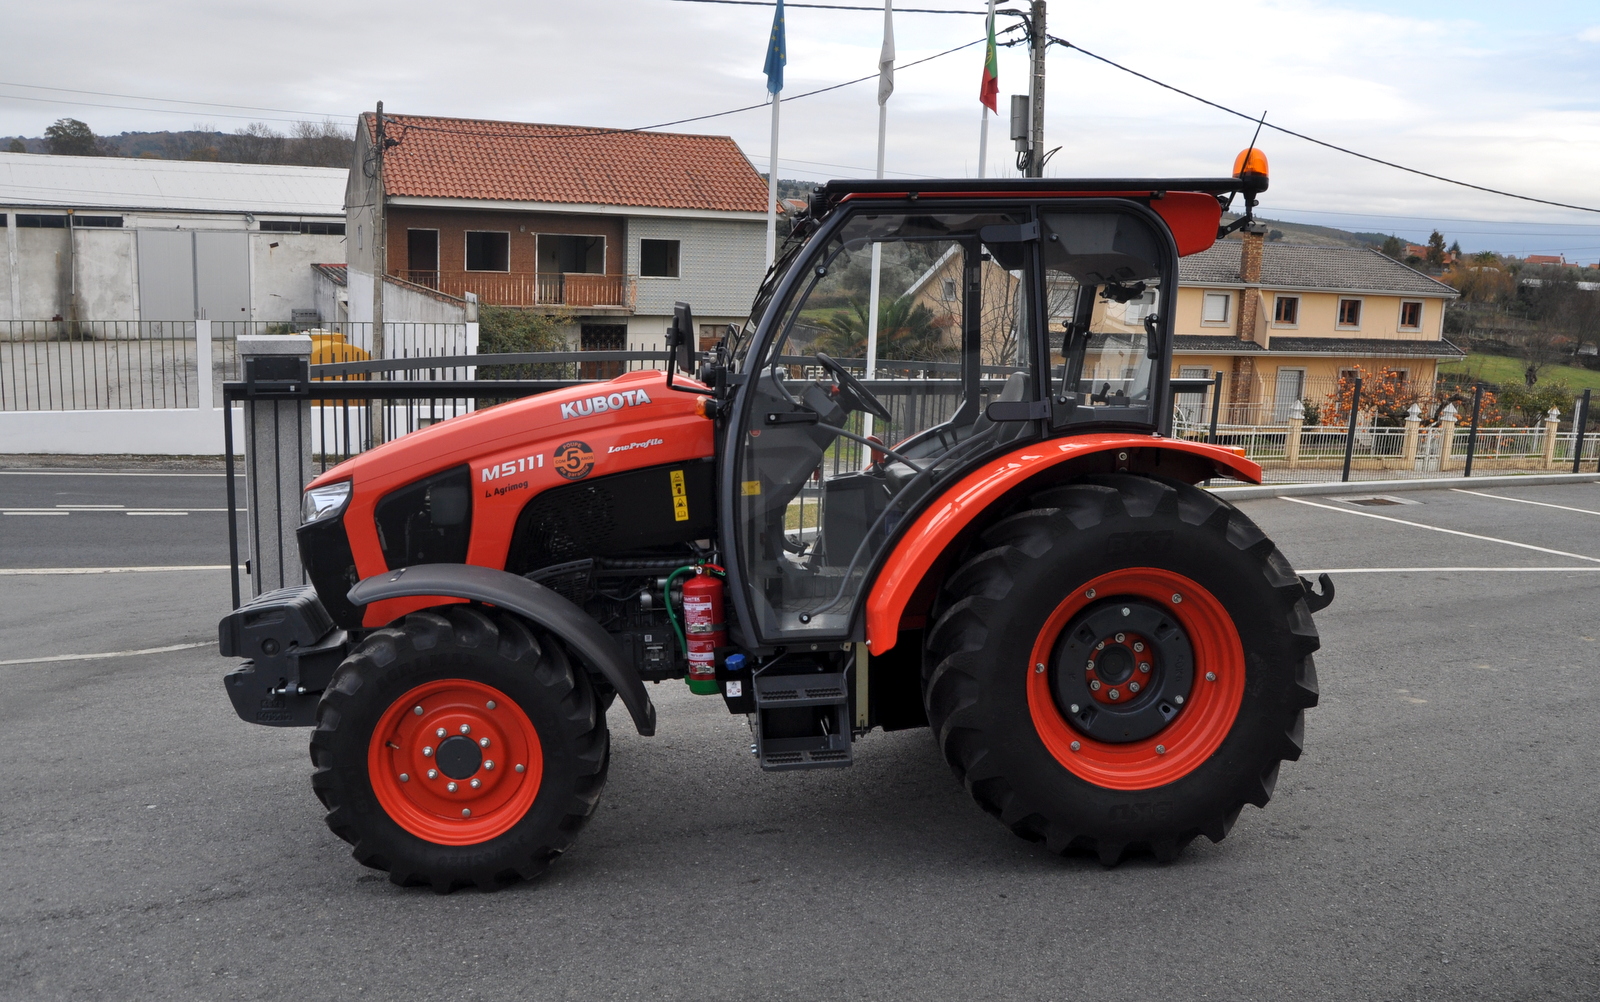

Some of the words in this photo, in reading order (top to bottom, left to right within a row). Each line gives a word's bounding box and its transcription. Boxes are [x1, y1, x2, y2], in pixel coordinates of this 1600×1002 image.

[560, 388, 652, 420] KUBOTA
[607, 438, 664, 453] LowProfile
[481, 453, 544, 483] M5111
[567, 450, 580, 469] 5
[494, 481, 528, 496] Agrimog
